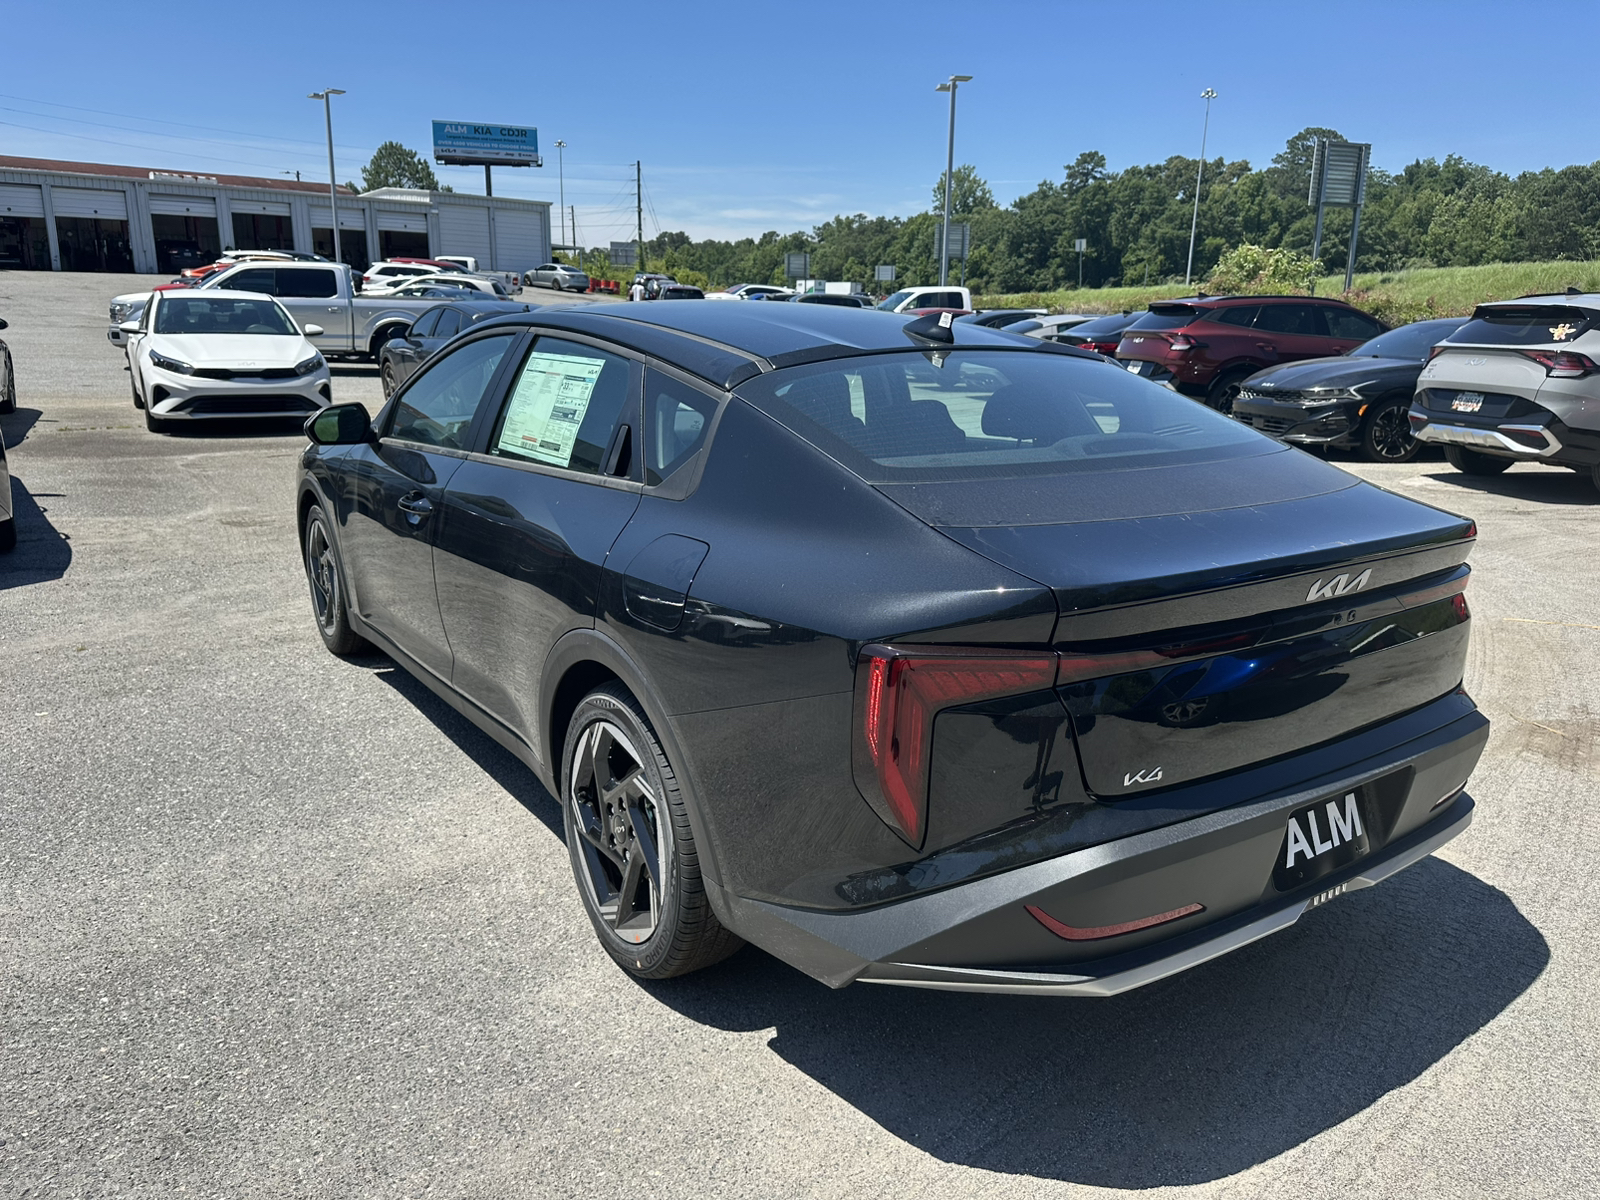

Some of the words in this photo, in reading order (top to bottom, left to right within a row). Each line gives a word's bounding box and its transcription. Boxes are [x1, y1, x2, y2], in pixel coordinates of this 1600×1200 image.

[444, 125, 467, 134] ALM
[473, 126, 492, 135] KIA
[500, 128, 527, 137] CDJR
[1305, 568, 1373, 602] KIA
[1122, 766, 1164, 787] K4
[1285, 792, 1363, 869] ALM
[645, 926, 671, 966] KUMHO
